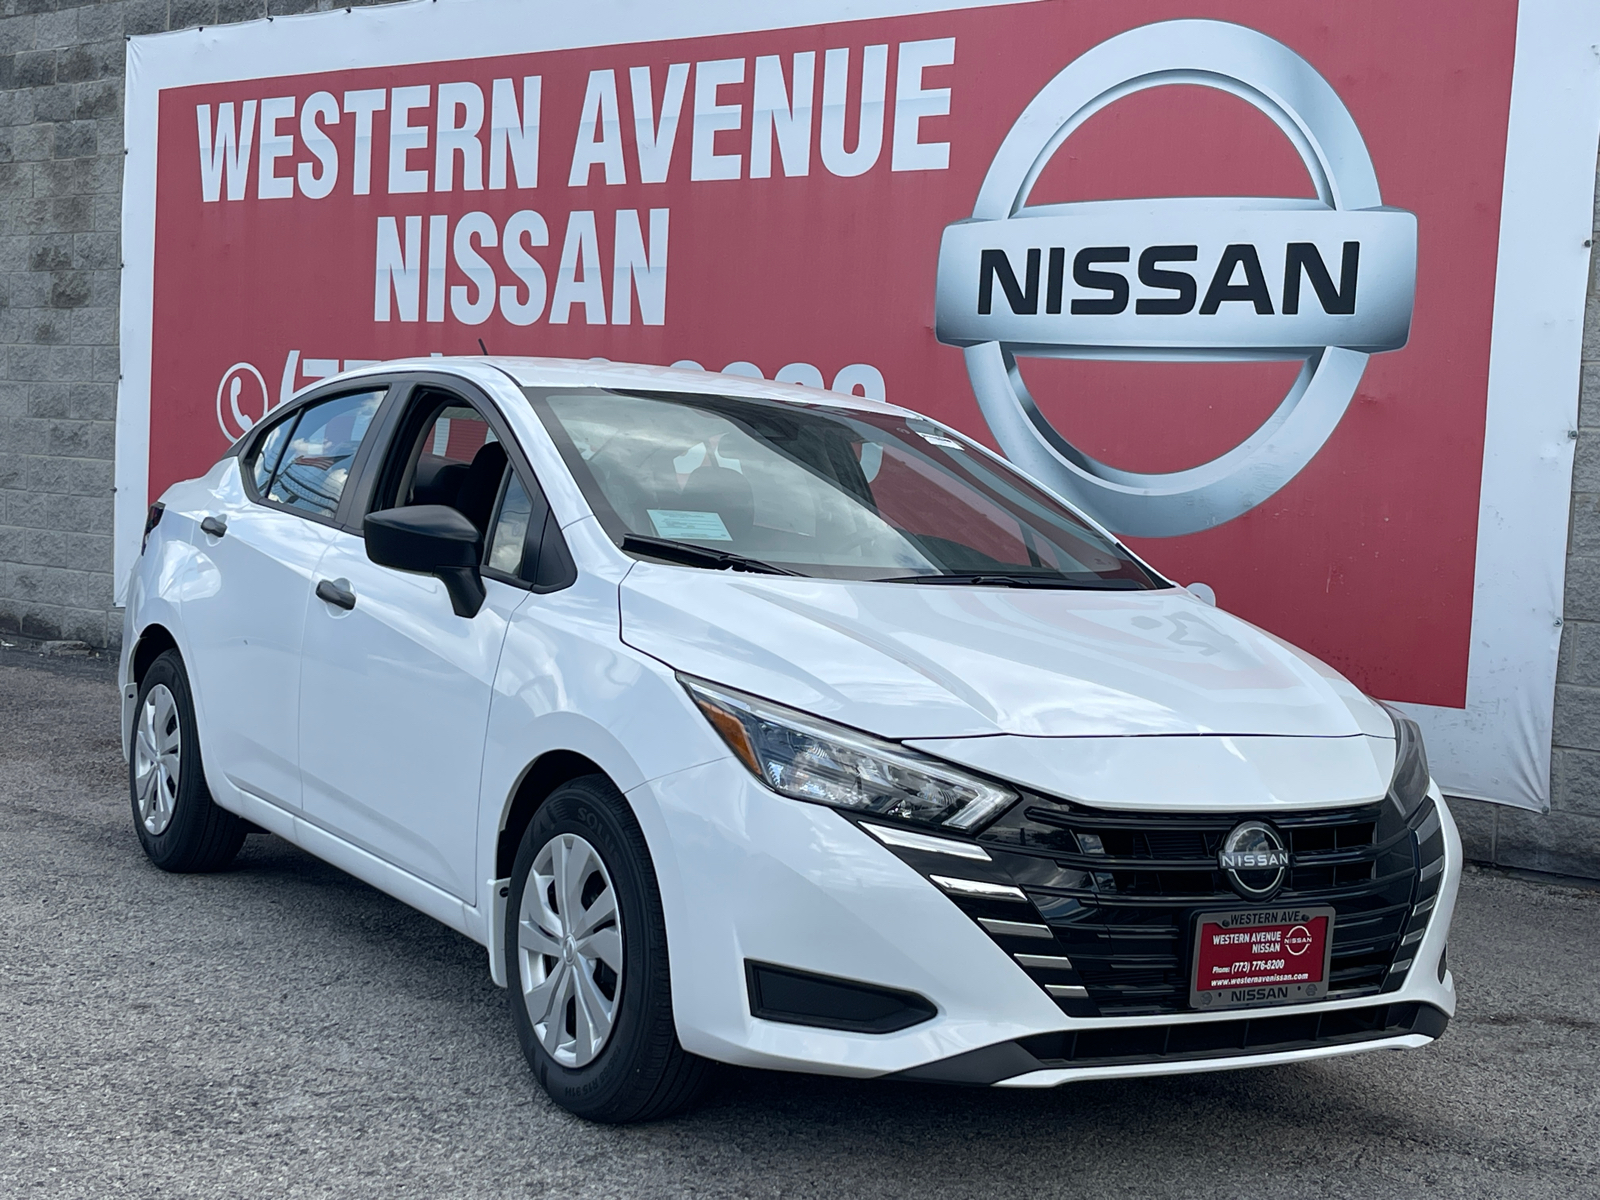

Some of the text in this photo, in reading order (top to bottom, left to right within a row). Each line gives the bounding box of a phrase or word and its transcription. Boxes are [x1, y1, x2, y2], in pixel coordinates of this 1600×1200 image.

[197, 37, 956, 203] WESTERN AVENUE
[373, 208, 670, 327] NISSAN
[977, 241, 1360, 315] NISSAN
[576, 806, 622, 866] SOLUS
[1222, 853, 1288, 867] NISSAN
[1230, 912, 1279, 925] WESTERN
[1213, 931, 1281, 945] WESTERN AVENUE
[1252, 942, 1280, 954] NISSAN
[1231, 962, 1250, 974] (773)
[1252, 959, 1284, 971] 776-8200
[1211, 973, 1308, 986] www.westernavenissan.com
[1231, 987, 1288, 1002] NISSAN
